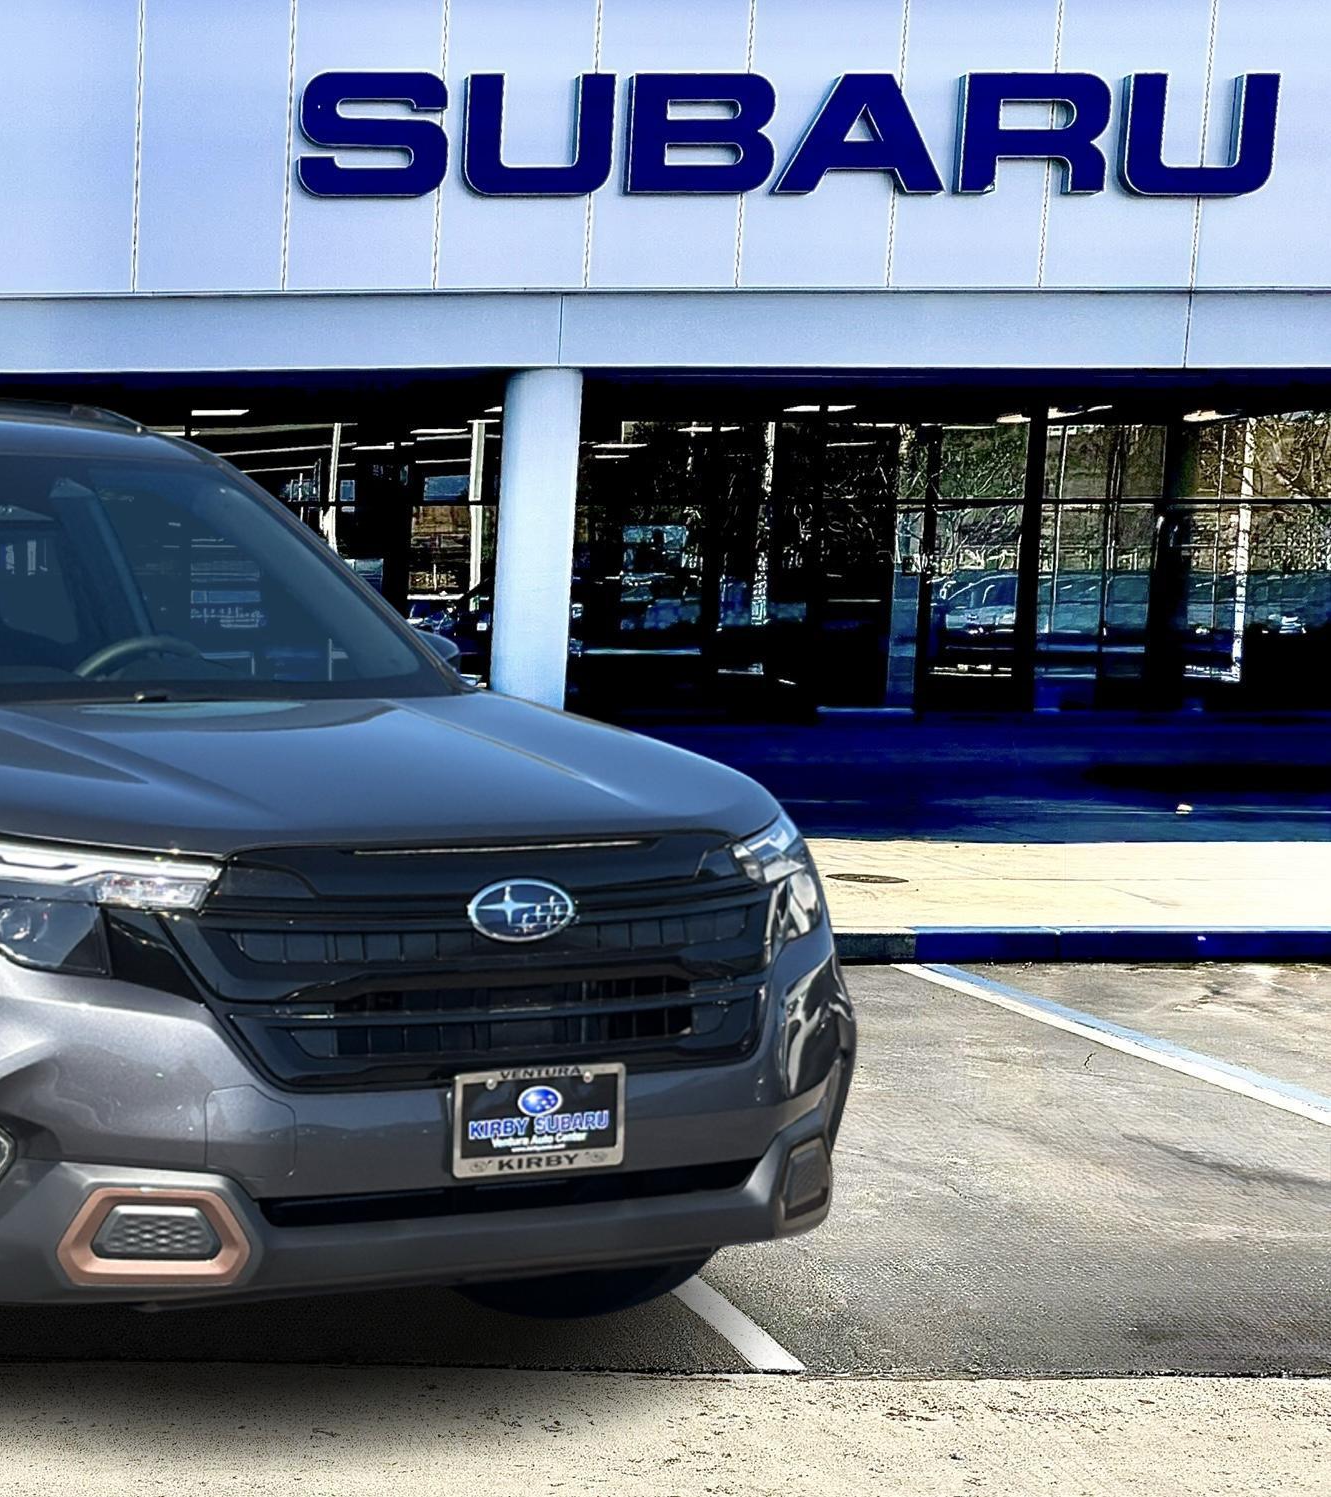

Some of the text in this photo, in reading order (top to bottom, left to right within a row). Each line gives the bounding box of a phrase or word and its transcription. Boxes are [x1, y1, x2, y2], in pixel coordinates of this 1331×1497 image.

[298, 71, 1281, 198] SUBARU
[501, 1066, 581, 1079] VENTURA
[469, 1111, 609, 1139] KIRBY SUBARU
[530, 1134, 554, 1145] Auto
[555, 1132, 587, 1143] Center
[498, 1154, 578, 1171] KIRBY
